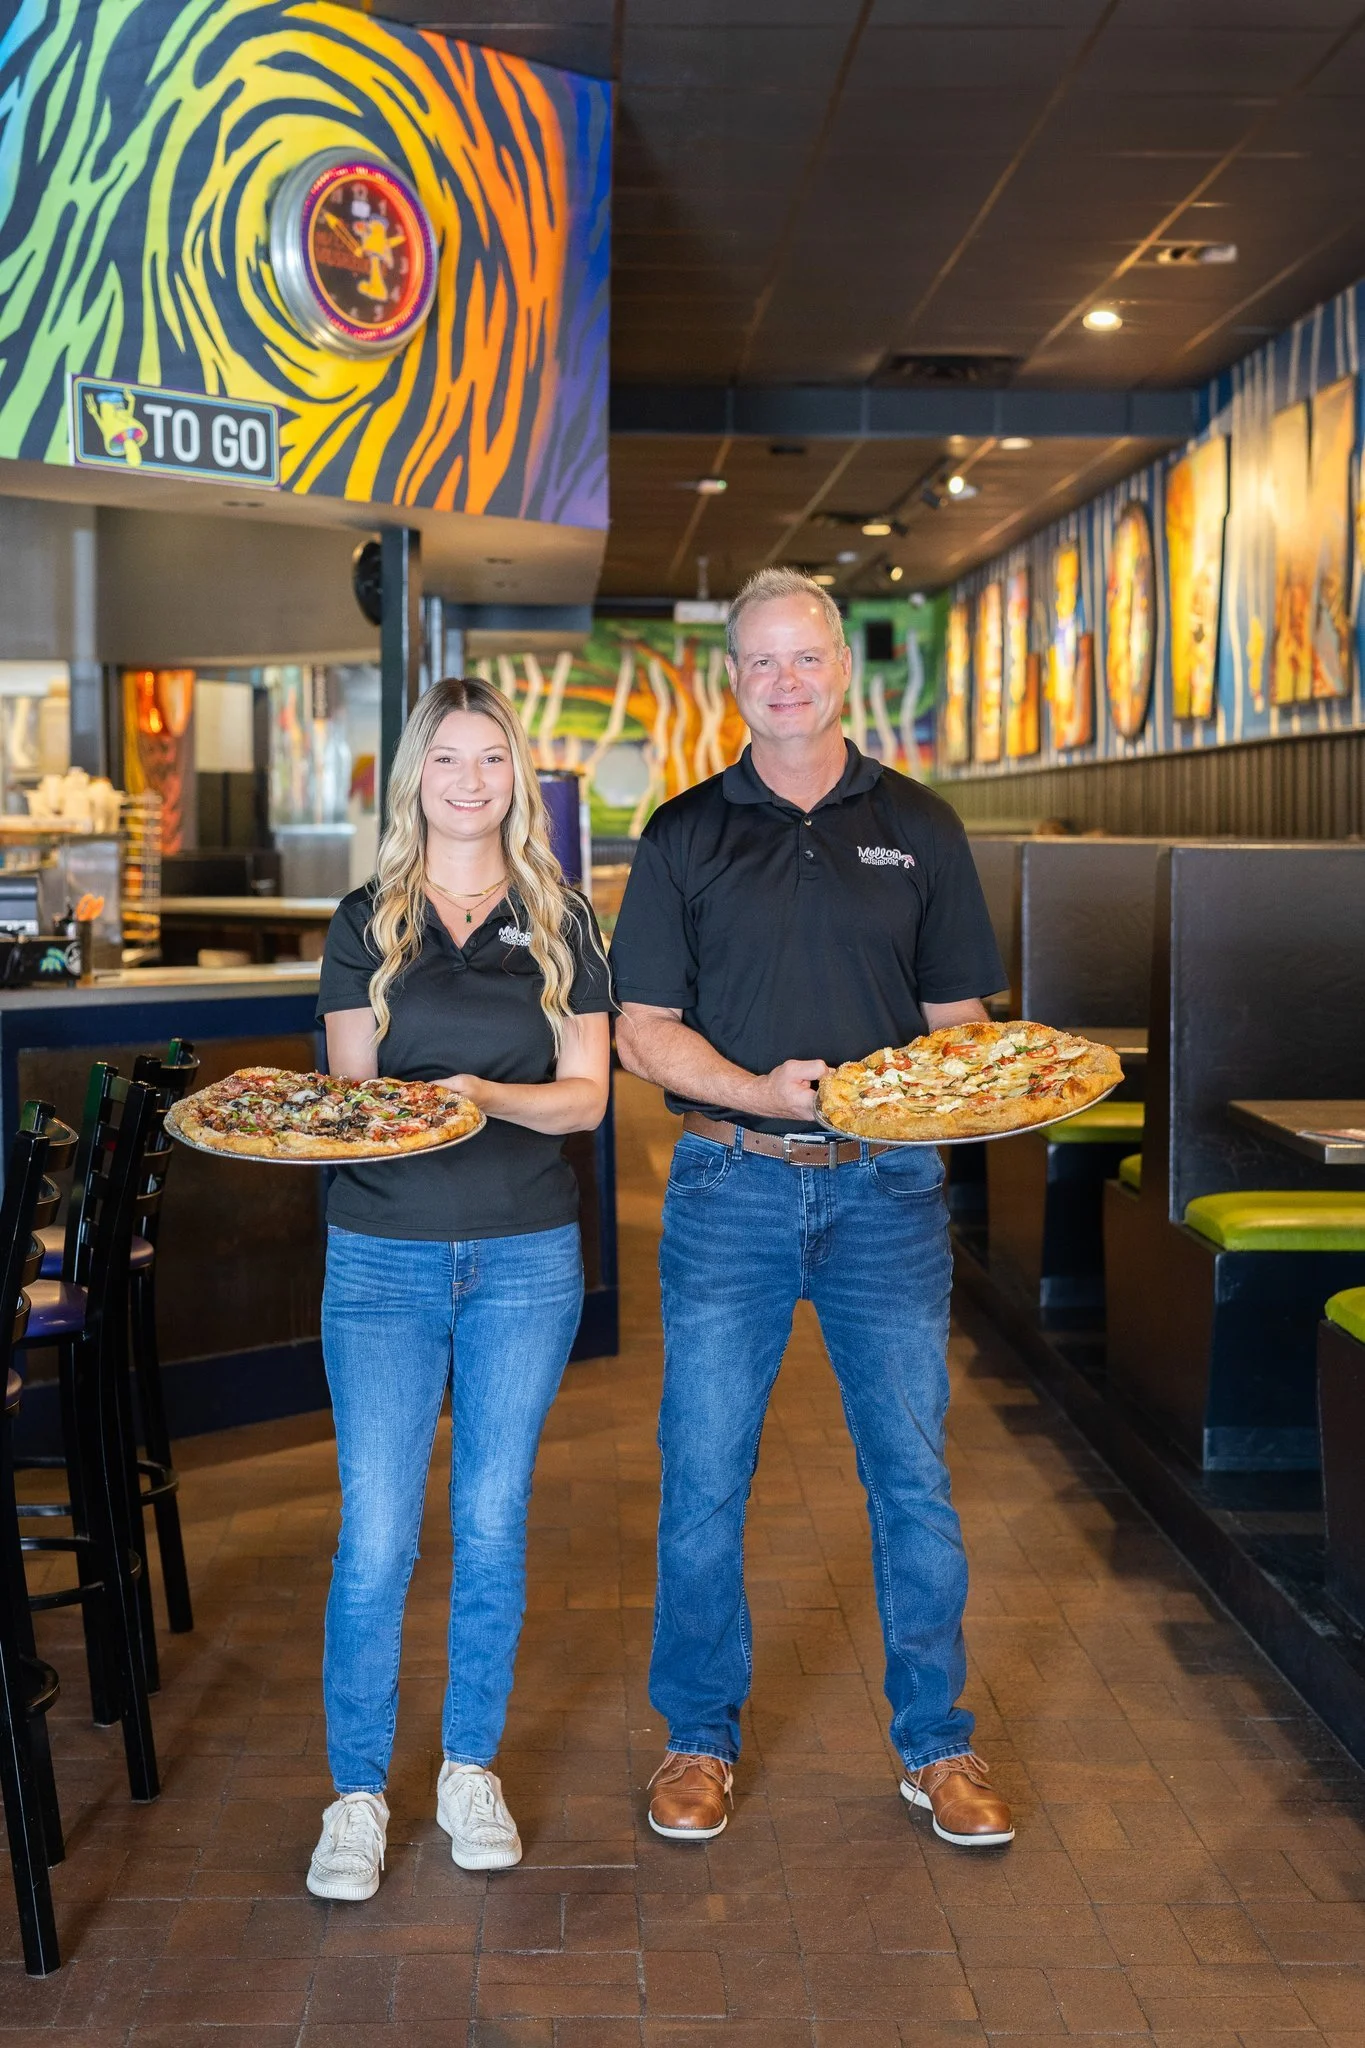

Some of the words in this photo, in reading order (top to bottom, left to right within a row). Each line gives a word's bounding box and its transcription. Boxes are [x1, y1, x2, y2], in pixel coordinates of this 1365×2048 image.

[143, 403, 200, 463] TO
[212, 414, 267, 471] GO
[857, 846, 902, 861] Mellow
